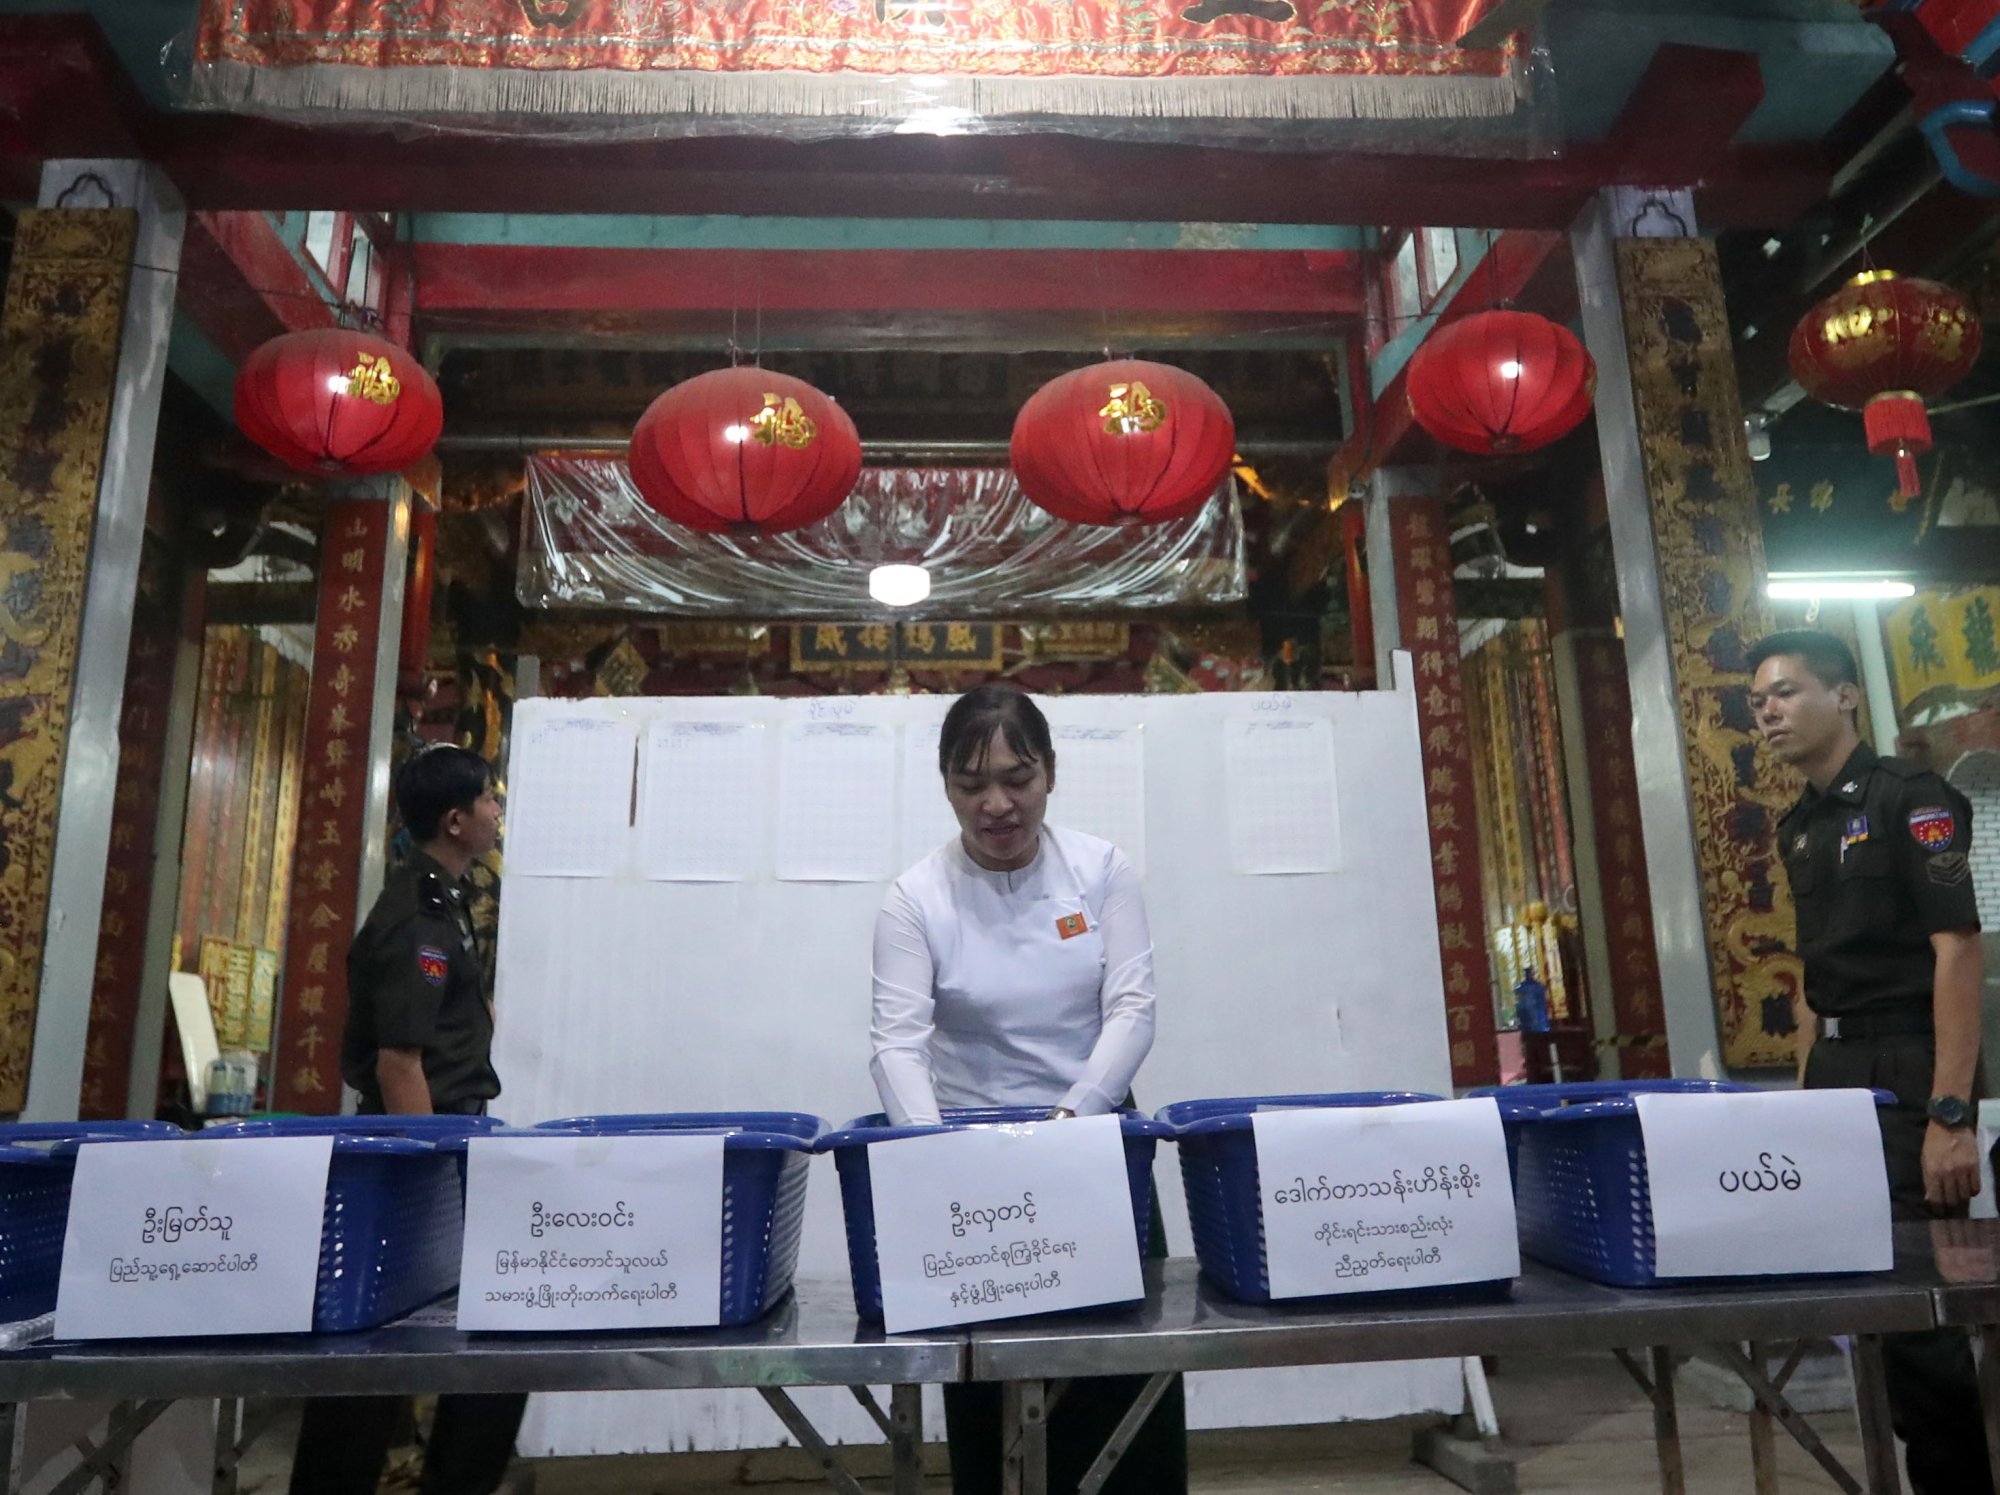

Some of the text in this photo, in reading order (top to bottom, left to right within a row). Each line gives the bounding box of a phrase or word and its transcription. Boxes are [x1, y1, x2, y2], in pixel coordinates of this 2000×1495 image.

[1274, 1163, 1481, 1204] ဒေါက်တာသန်းဟိန်းစိုး
[1718, 1151, 1802, 1193] ပယ်မဲ
[141, 1204, 233, 1244] ဦးမြတ်သူ
[530, 1200, 635, 1238] ဦးလေးဝင်း
